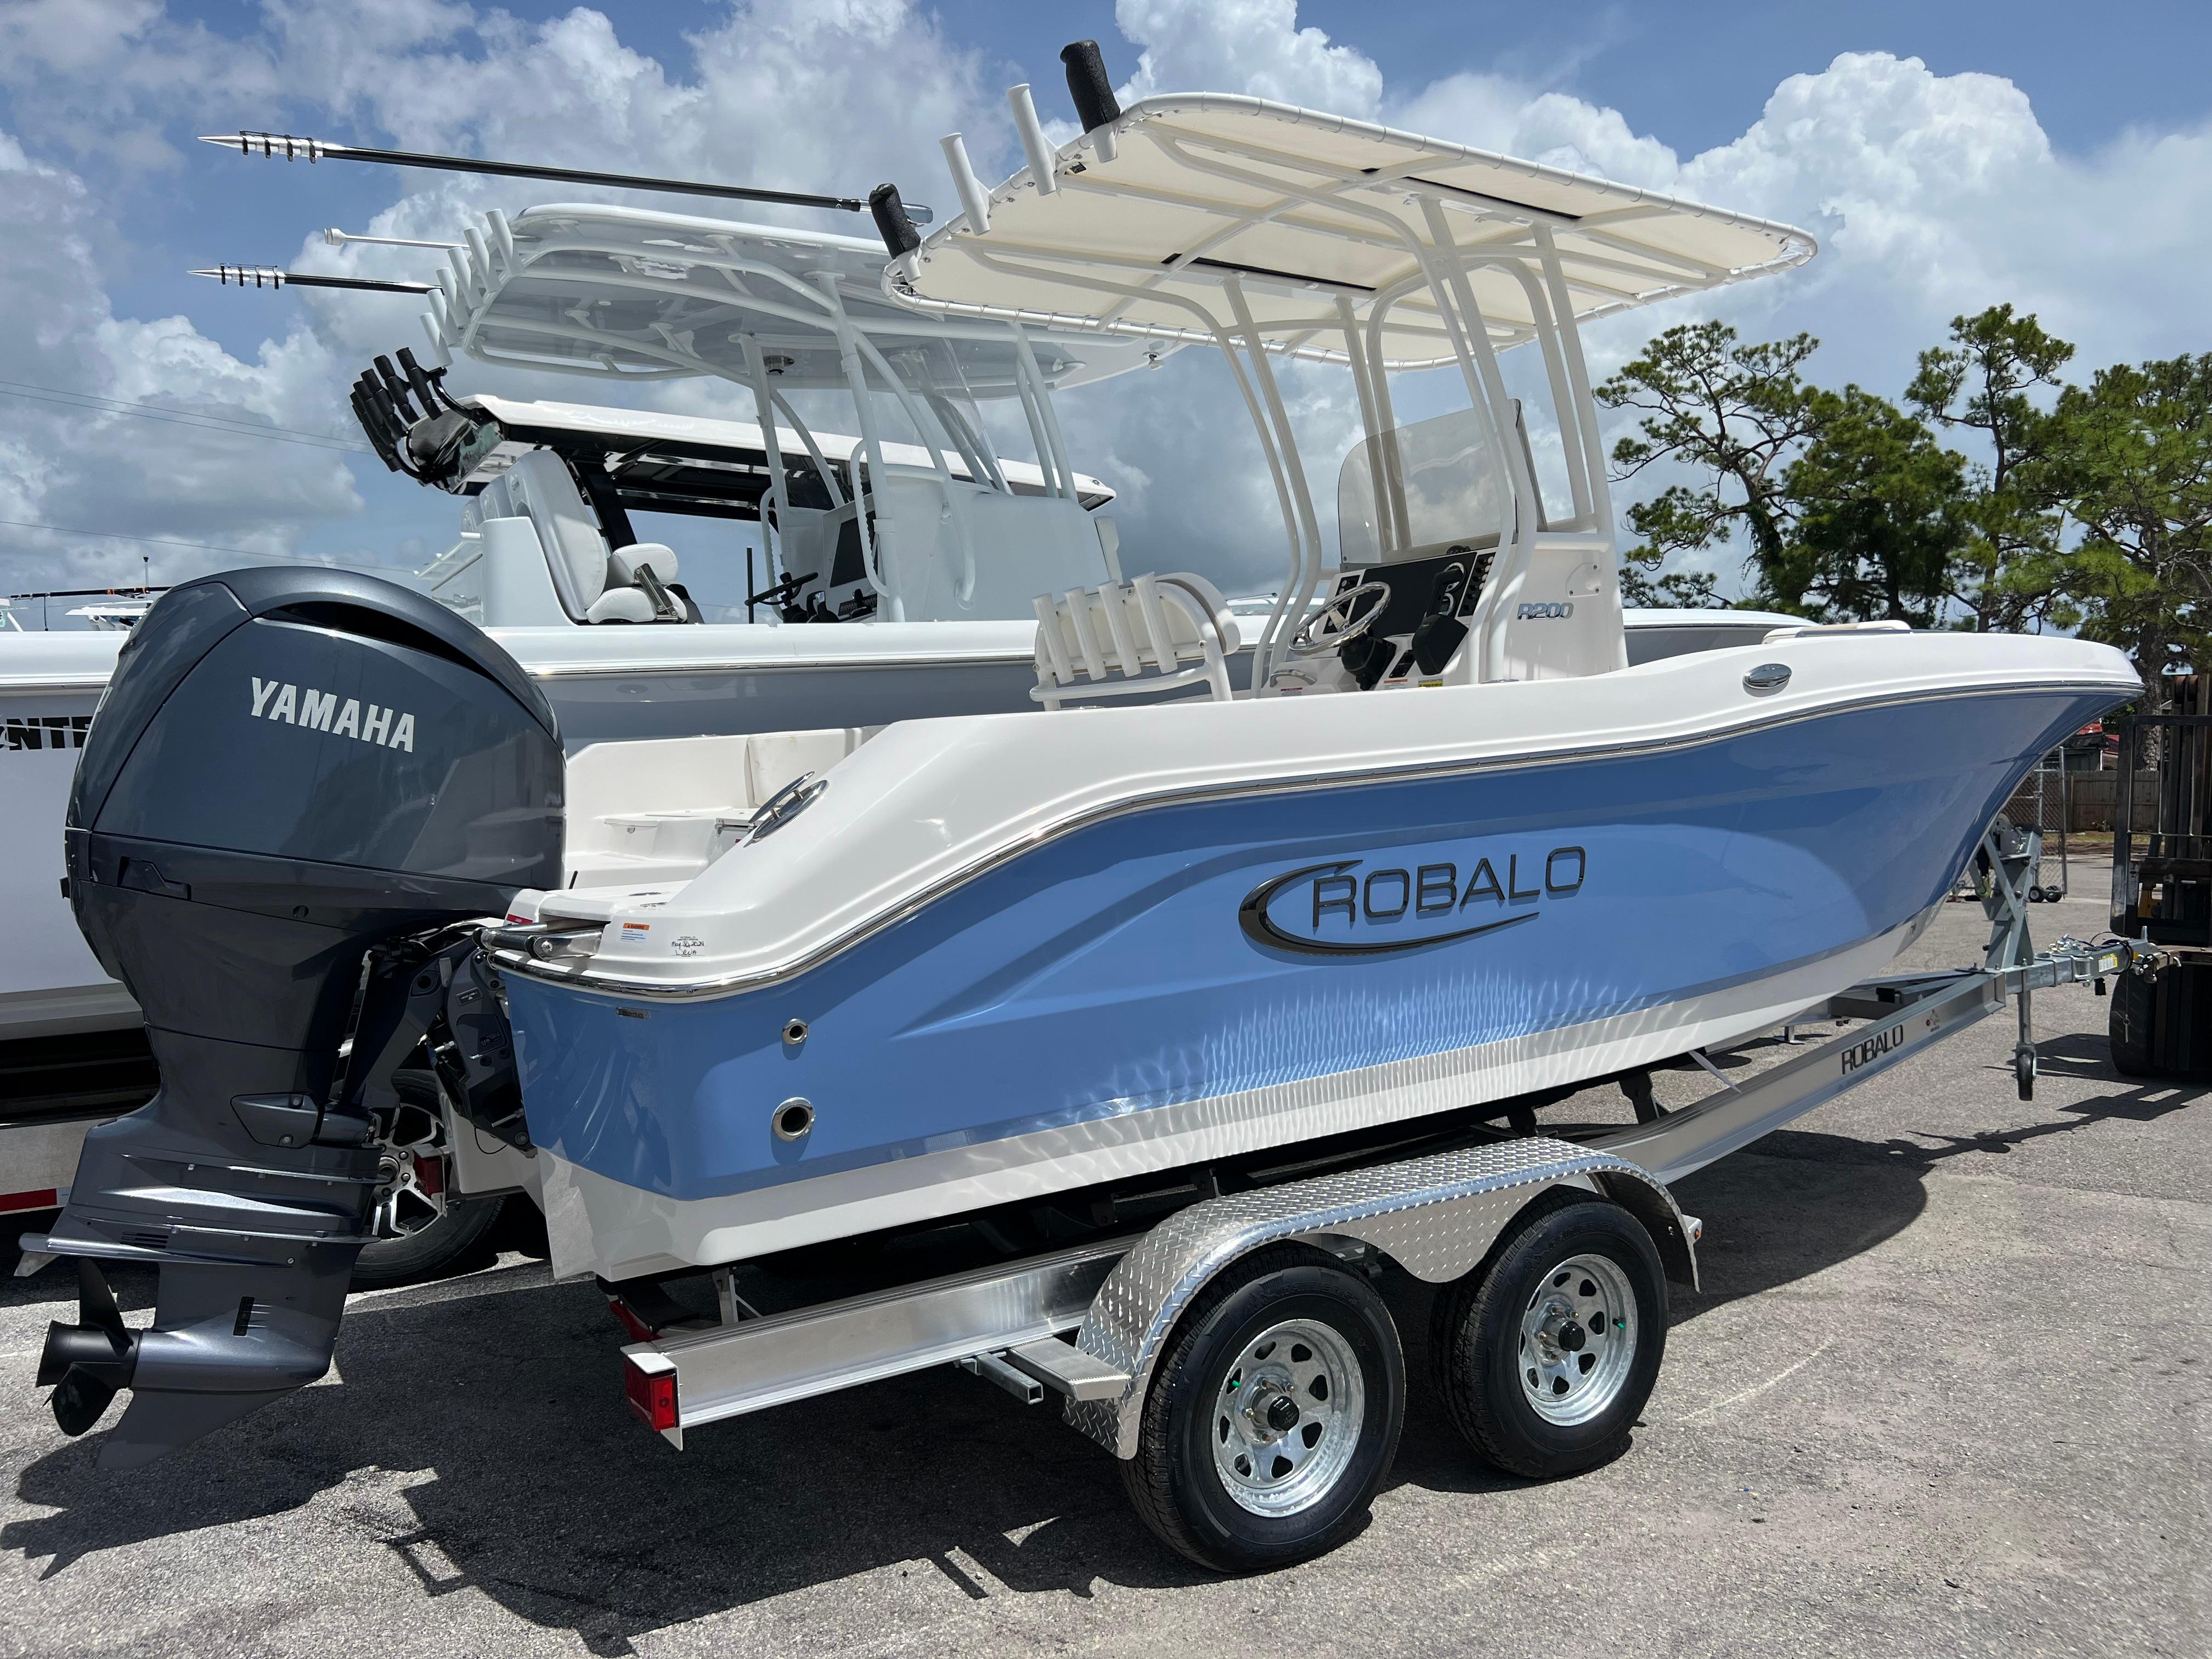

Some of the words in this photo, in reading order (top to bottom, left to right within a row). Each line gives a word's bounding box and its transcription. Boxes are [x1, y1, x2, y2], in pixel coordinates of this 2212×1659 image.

[1517, 603, 1574, 620] R200
[251, 677, 415, 753] YAMAHA
[1312, 845, 1586, 927] ROBALO
[1841, 1024, 1904, 1075] ROBALO
